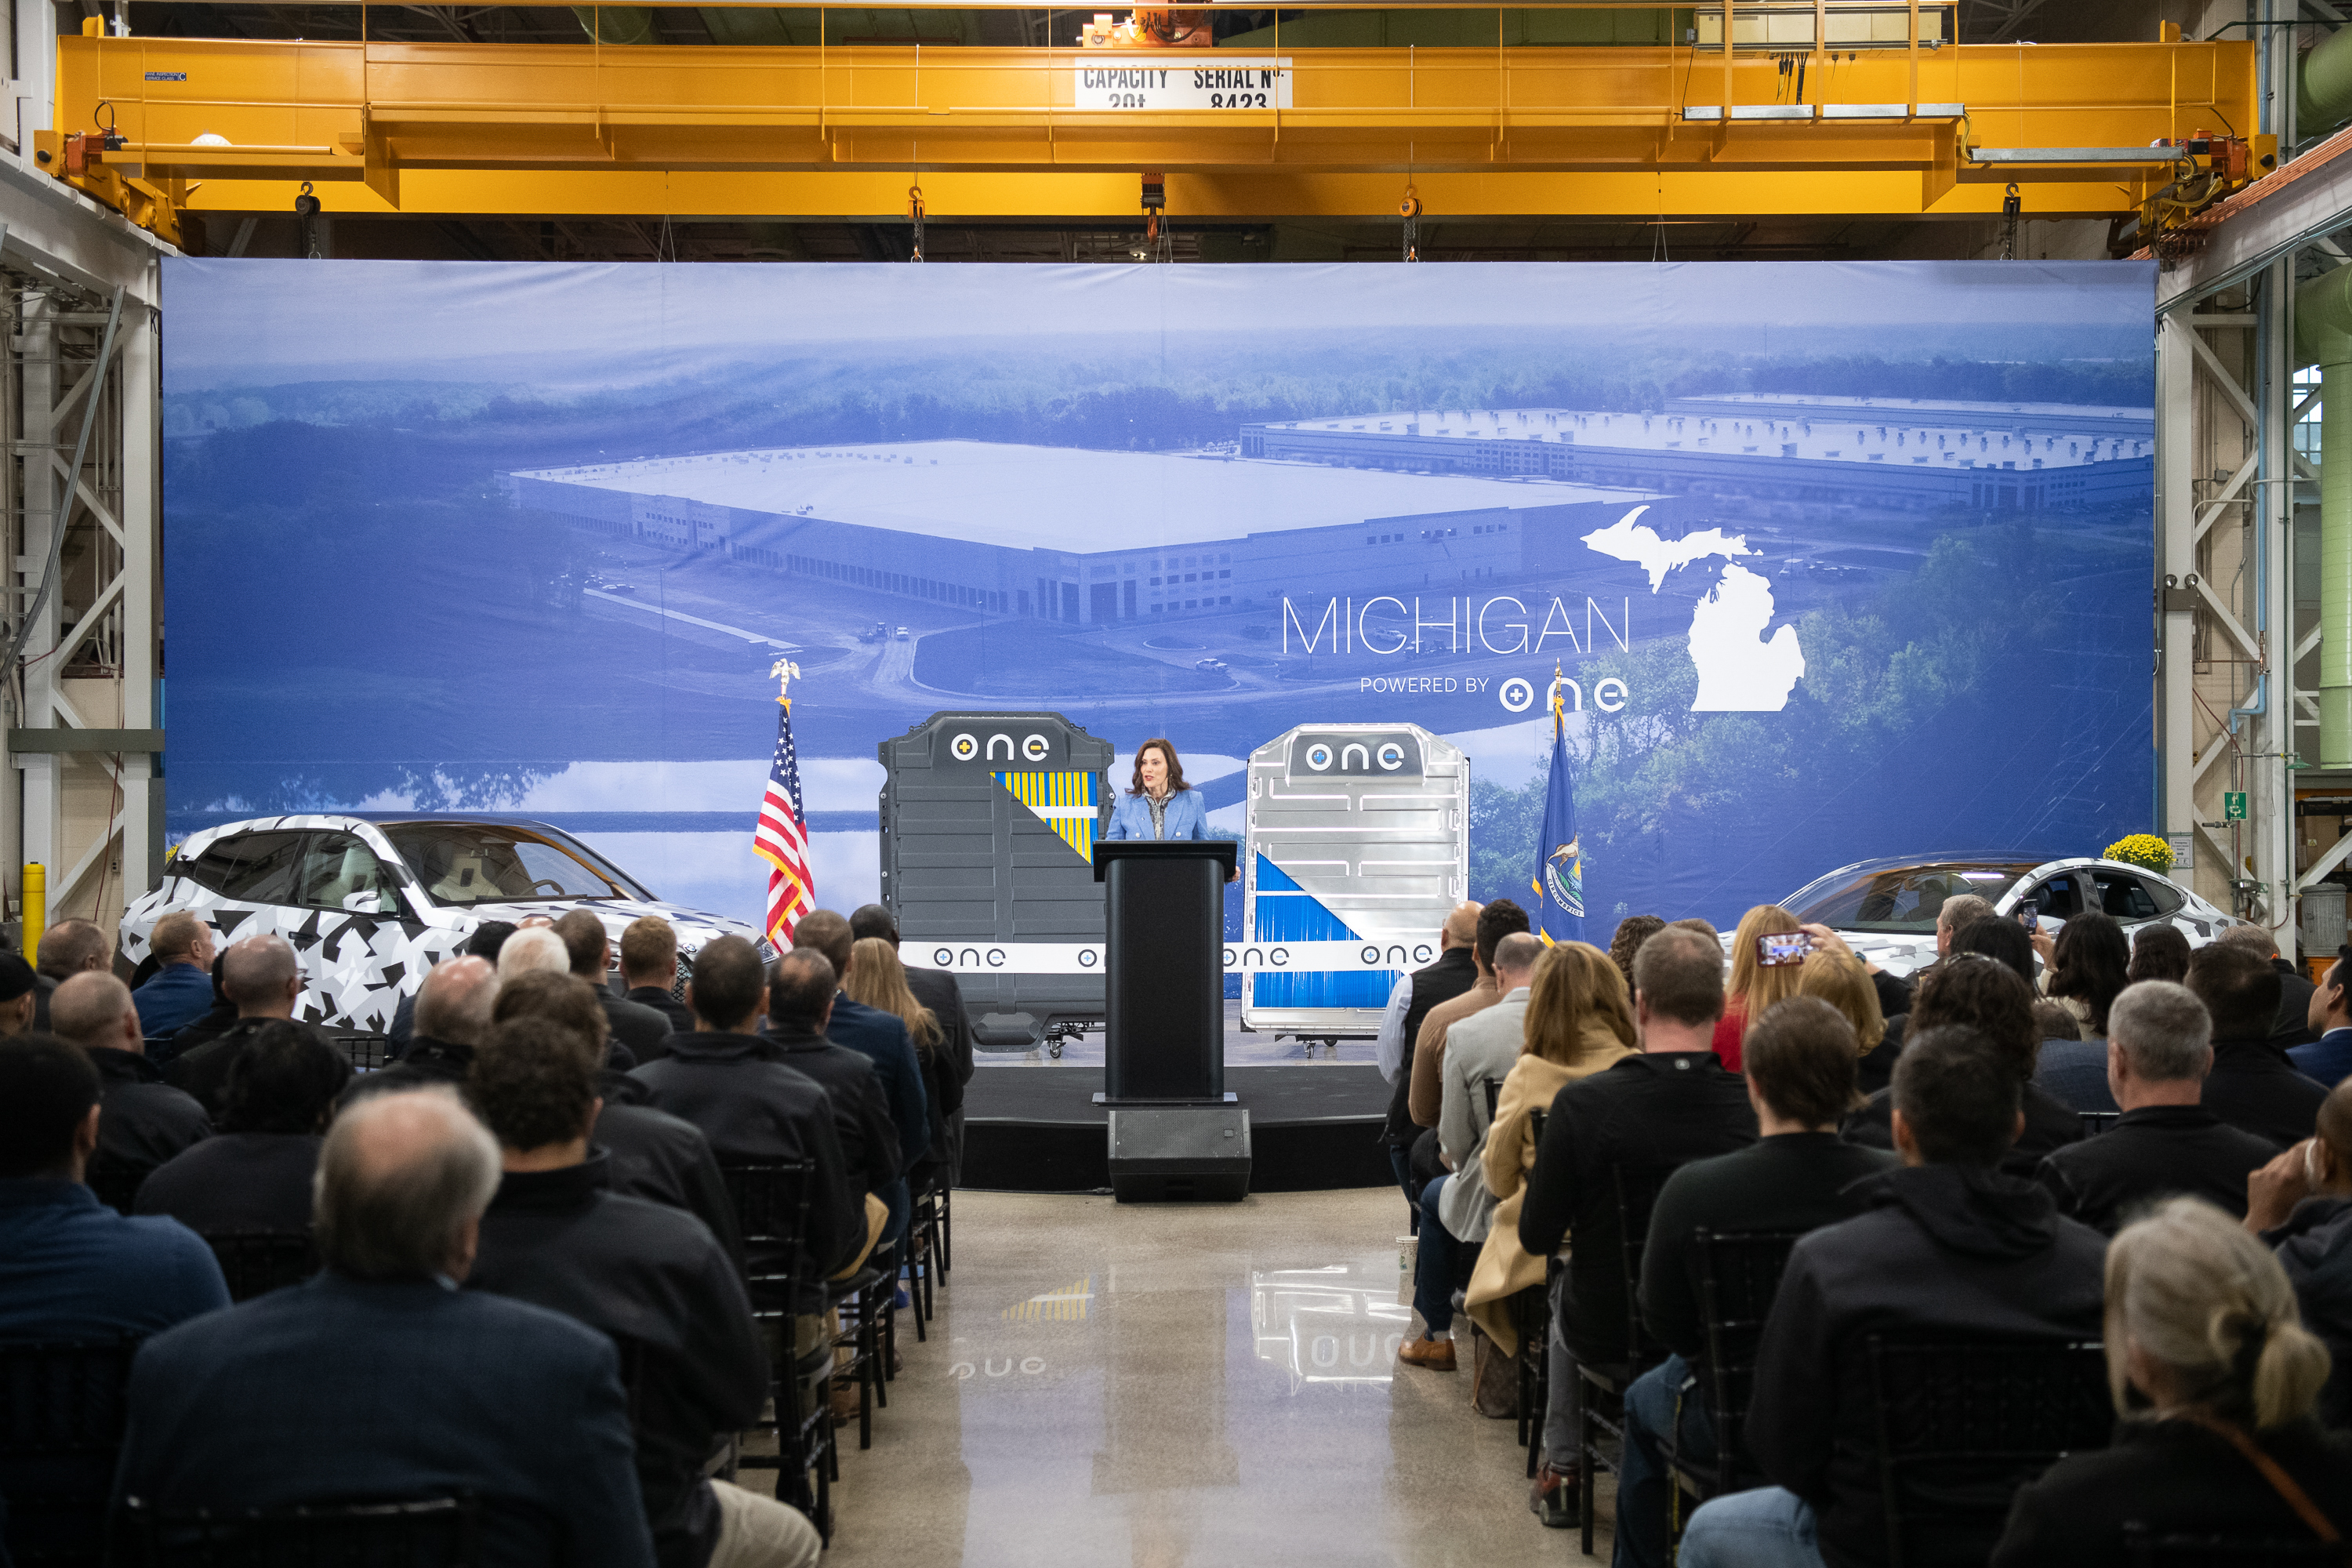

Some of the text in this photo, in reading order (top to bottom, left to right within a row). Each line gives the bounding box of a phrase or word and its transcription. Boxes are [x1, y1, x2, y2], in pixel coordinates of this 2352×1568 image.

[1083, 65, 1169, 89] CAPACITY
[1194, 65, 1254, 89] SERIAL
[1211, 93, 1266, 107] 8423
[1283, 596, 1629, 655] MICHIGAN
[1359, 677, 1629, 713] POWERED BY one
[950, 733, 1050, 761] one
[1305, 742, 1405, 771] one
[933, 947, 1006, 967] one
[1360, 944, 1433, 965] one
